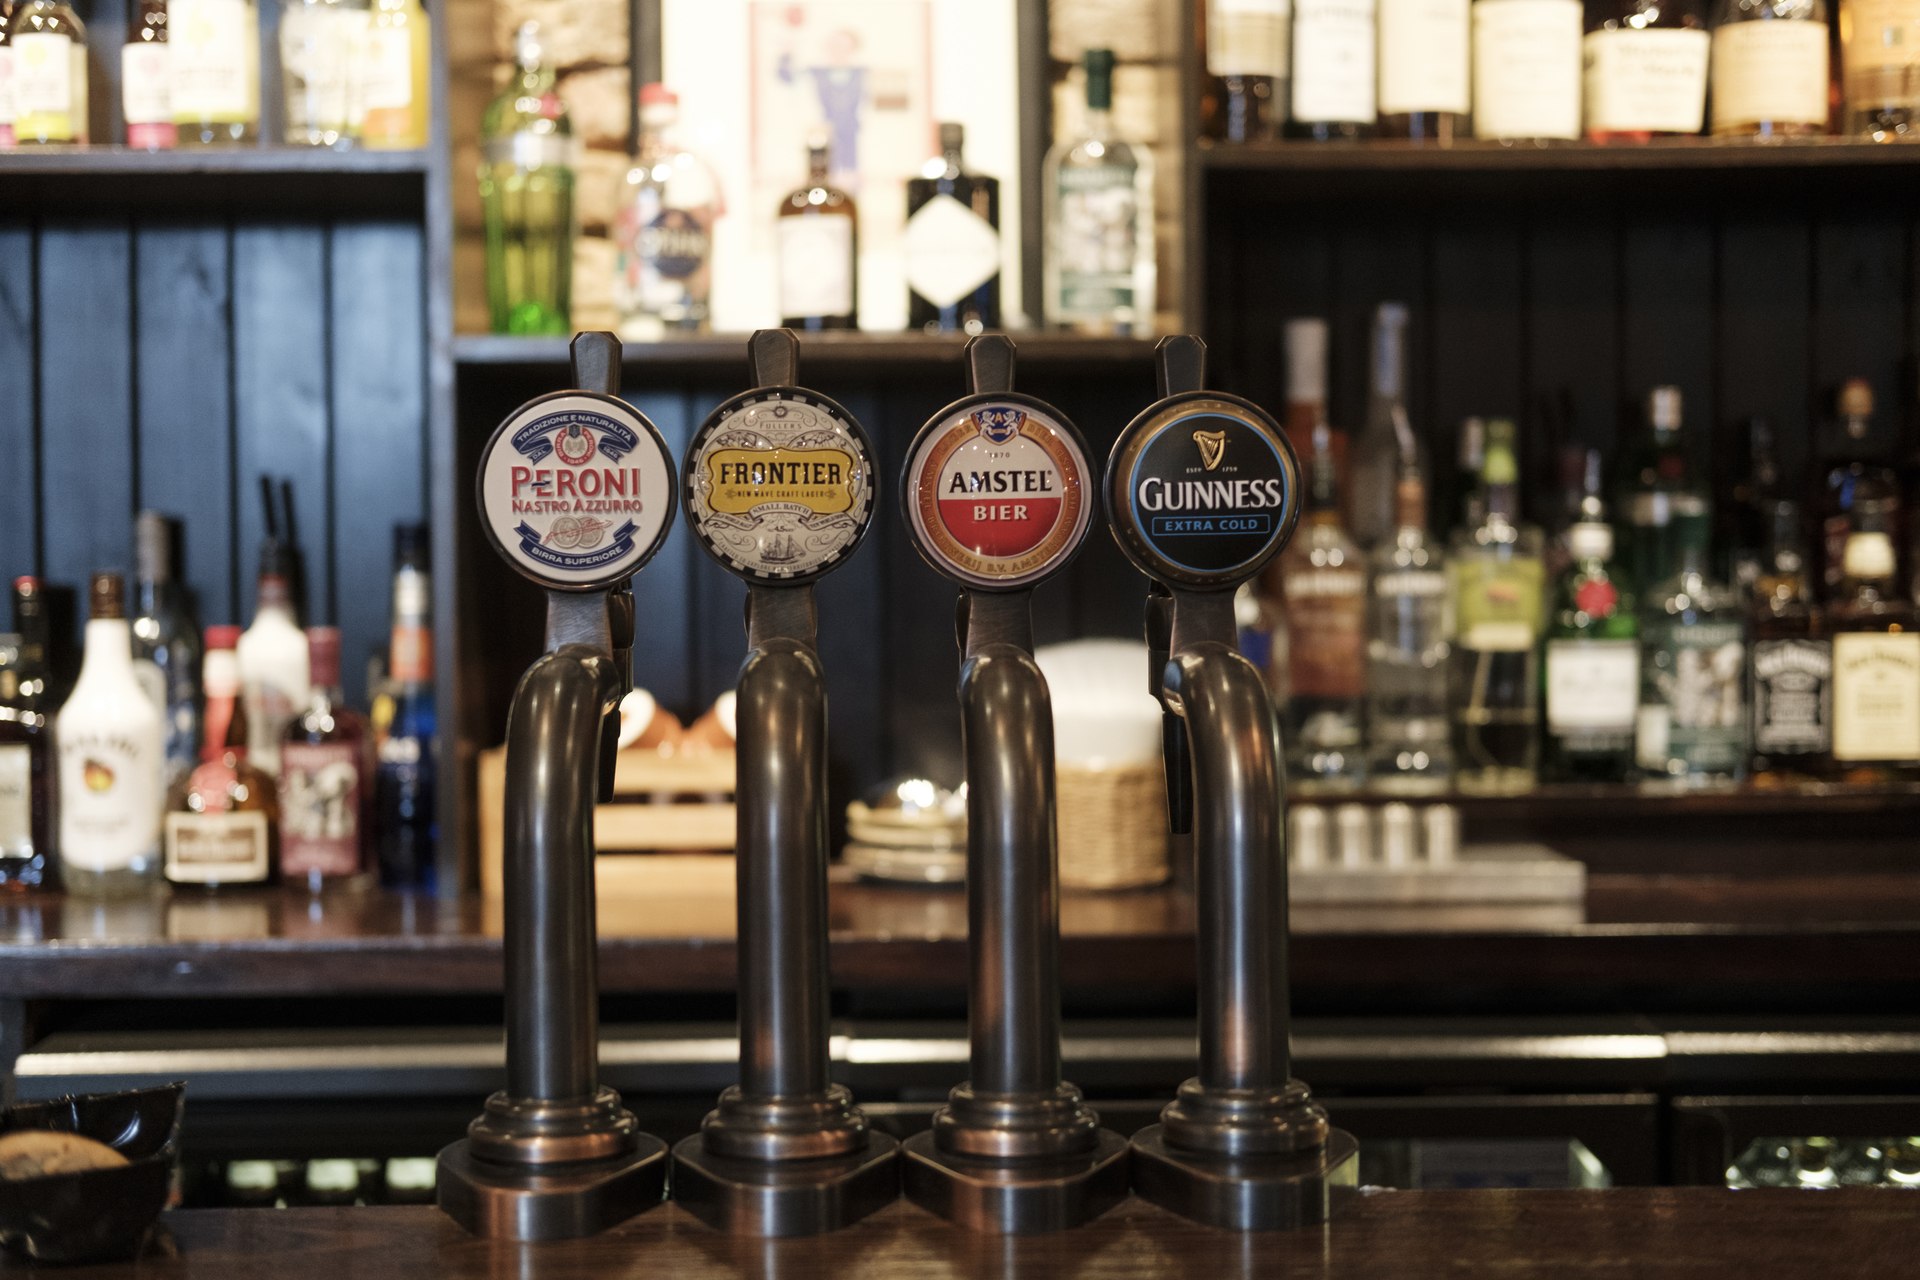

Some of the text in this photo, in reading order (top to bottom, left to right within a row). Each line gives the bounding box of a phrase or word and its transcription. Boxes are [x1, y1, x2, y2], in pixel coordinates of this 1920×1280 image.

[519, 415, 569, 442] TRADIZIONE
[511, 466, 642, 498] PERONI
[720, 461, 842, 485] FRONTIER
[949, 470, 1052, 494] AMSTEL
[1139, 477, 1282, 511] GUINNESS
[512, 499, 643, 514] NASTRO AZZURRO
[753, 503, 810, 514] SMALL BATCH
[974, 505, 1028, 521] BIER
[1164, 519, 1258, 531] EXTRA COLD
[531, 546, 623, 565] BIRRA SUPERIORE
